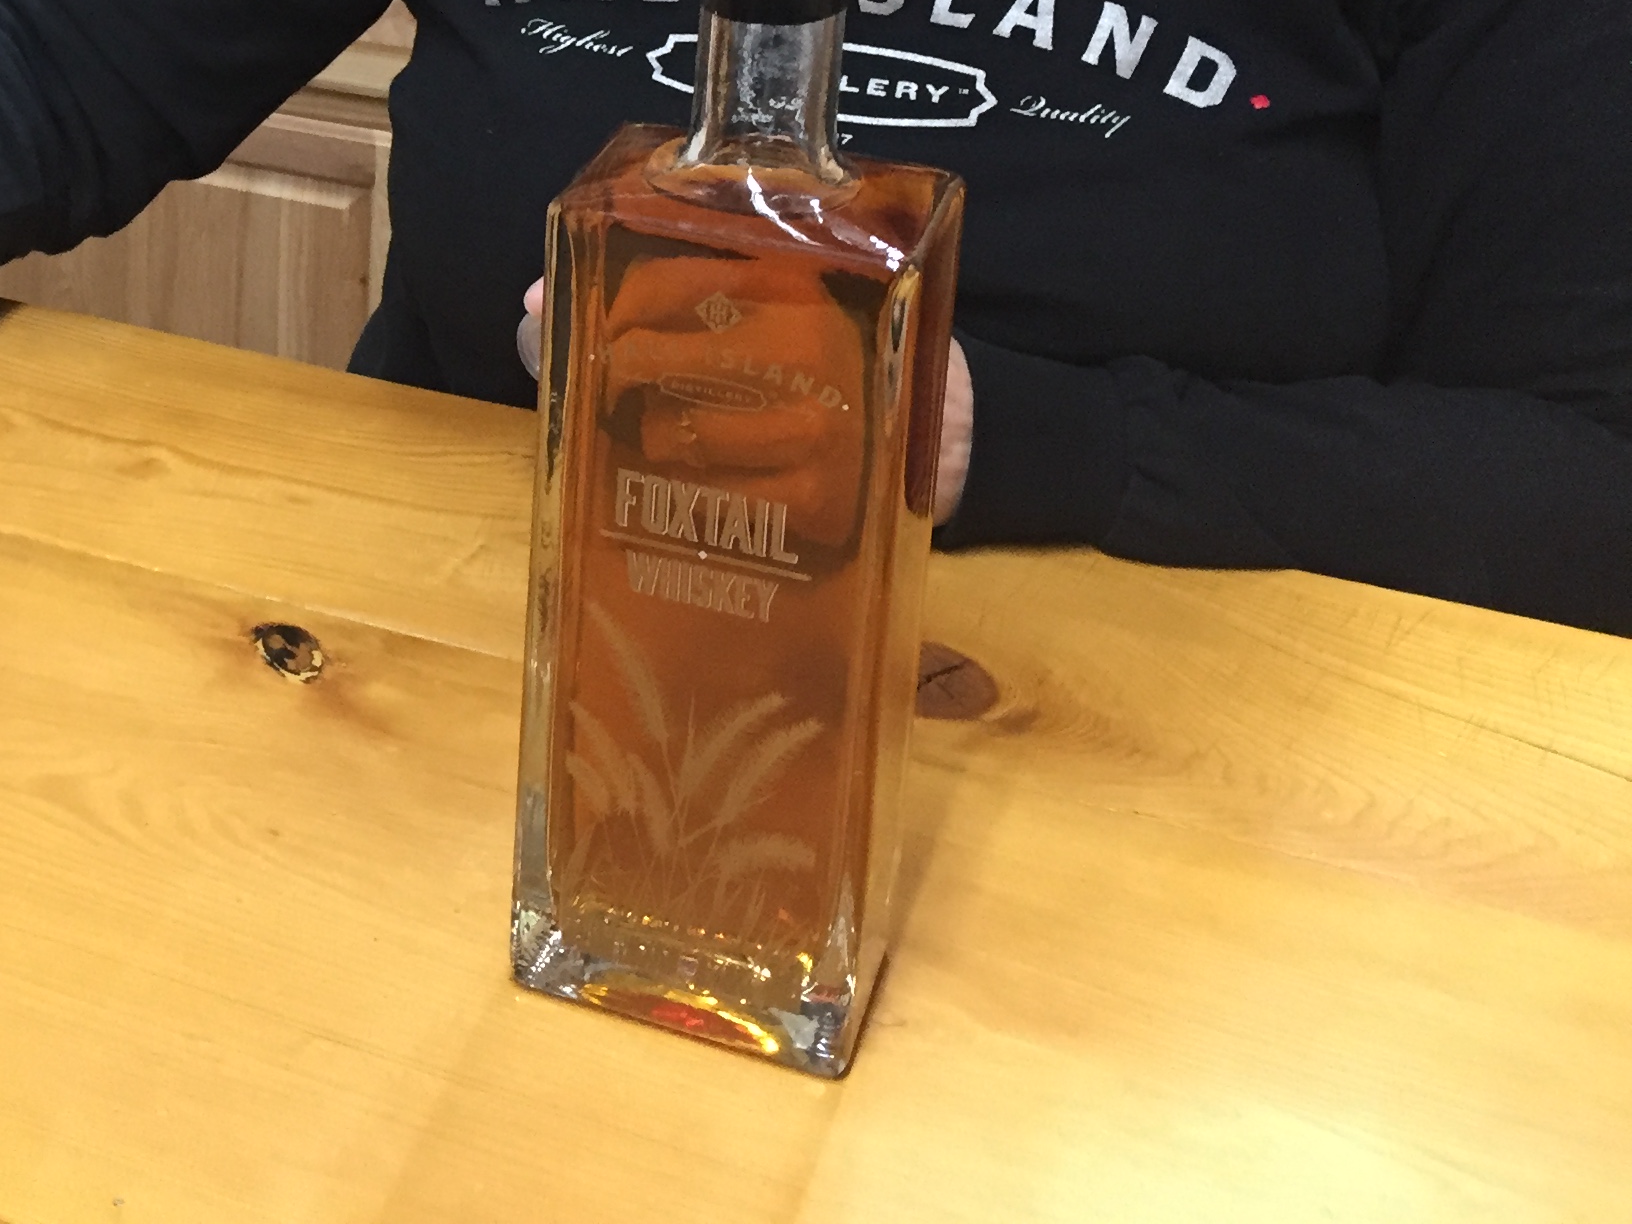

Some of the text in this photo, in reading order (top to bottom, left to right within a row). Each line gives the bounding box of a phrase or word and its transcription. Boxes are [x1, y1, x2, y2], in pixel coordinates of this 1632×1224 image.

[520, 17, 634, 58] Highest
[1009, 92, 1133, 139] Quality
[615, 467, 800, 565] FOXTAIL
[625, 548, 780, 624] WHISKEY
